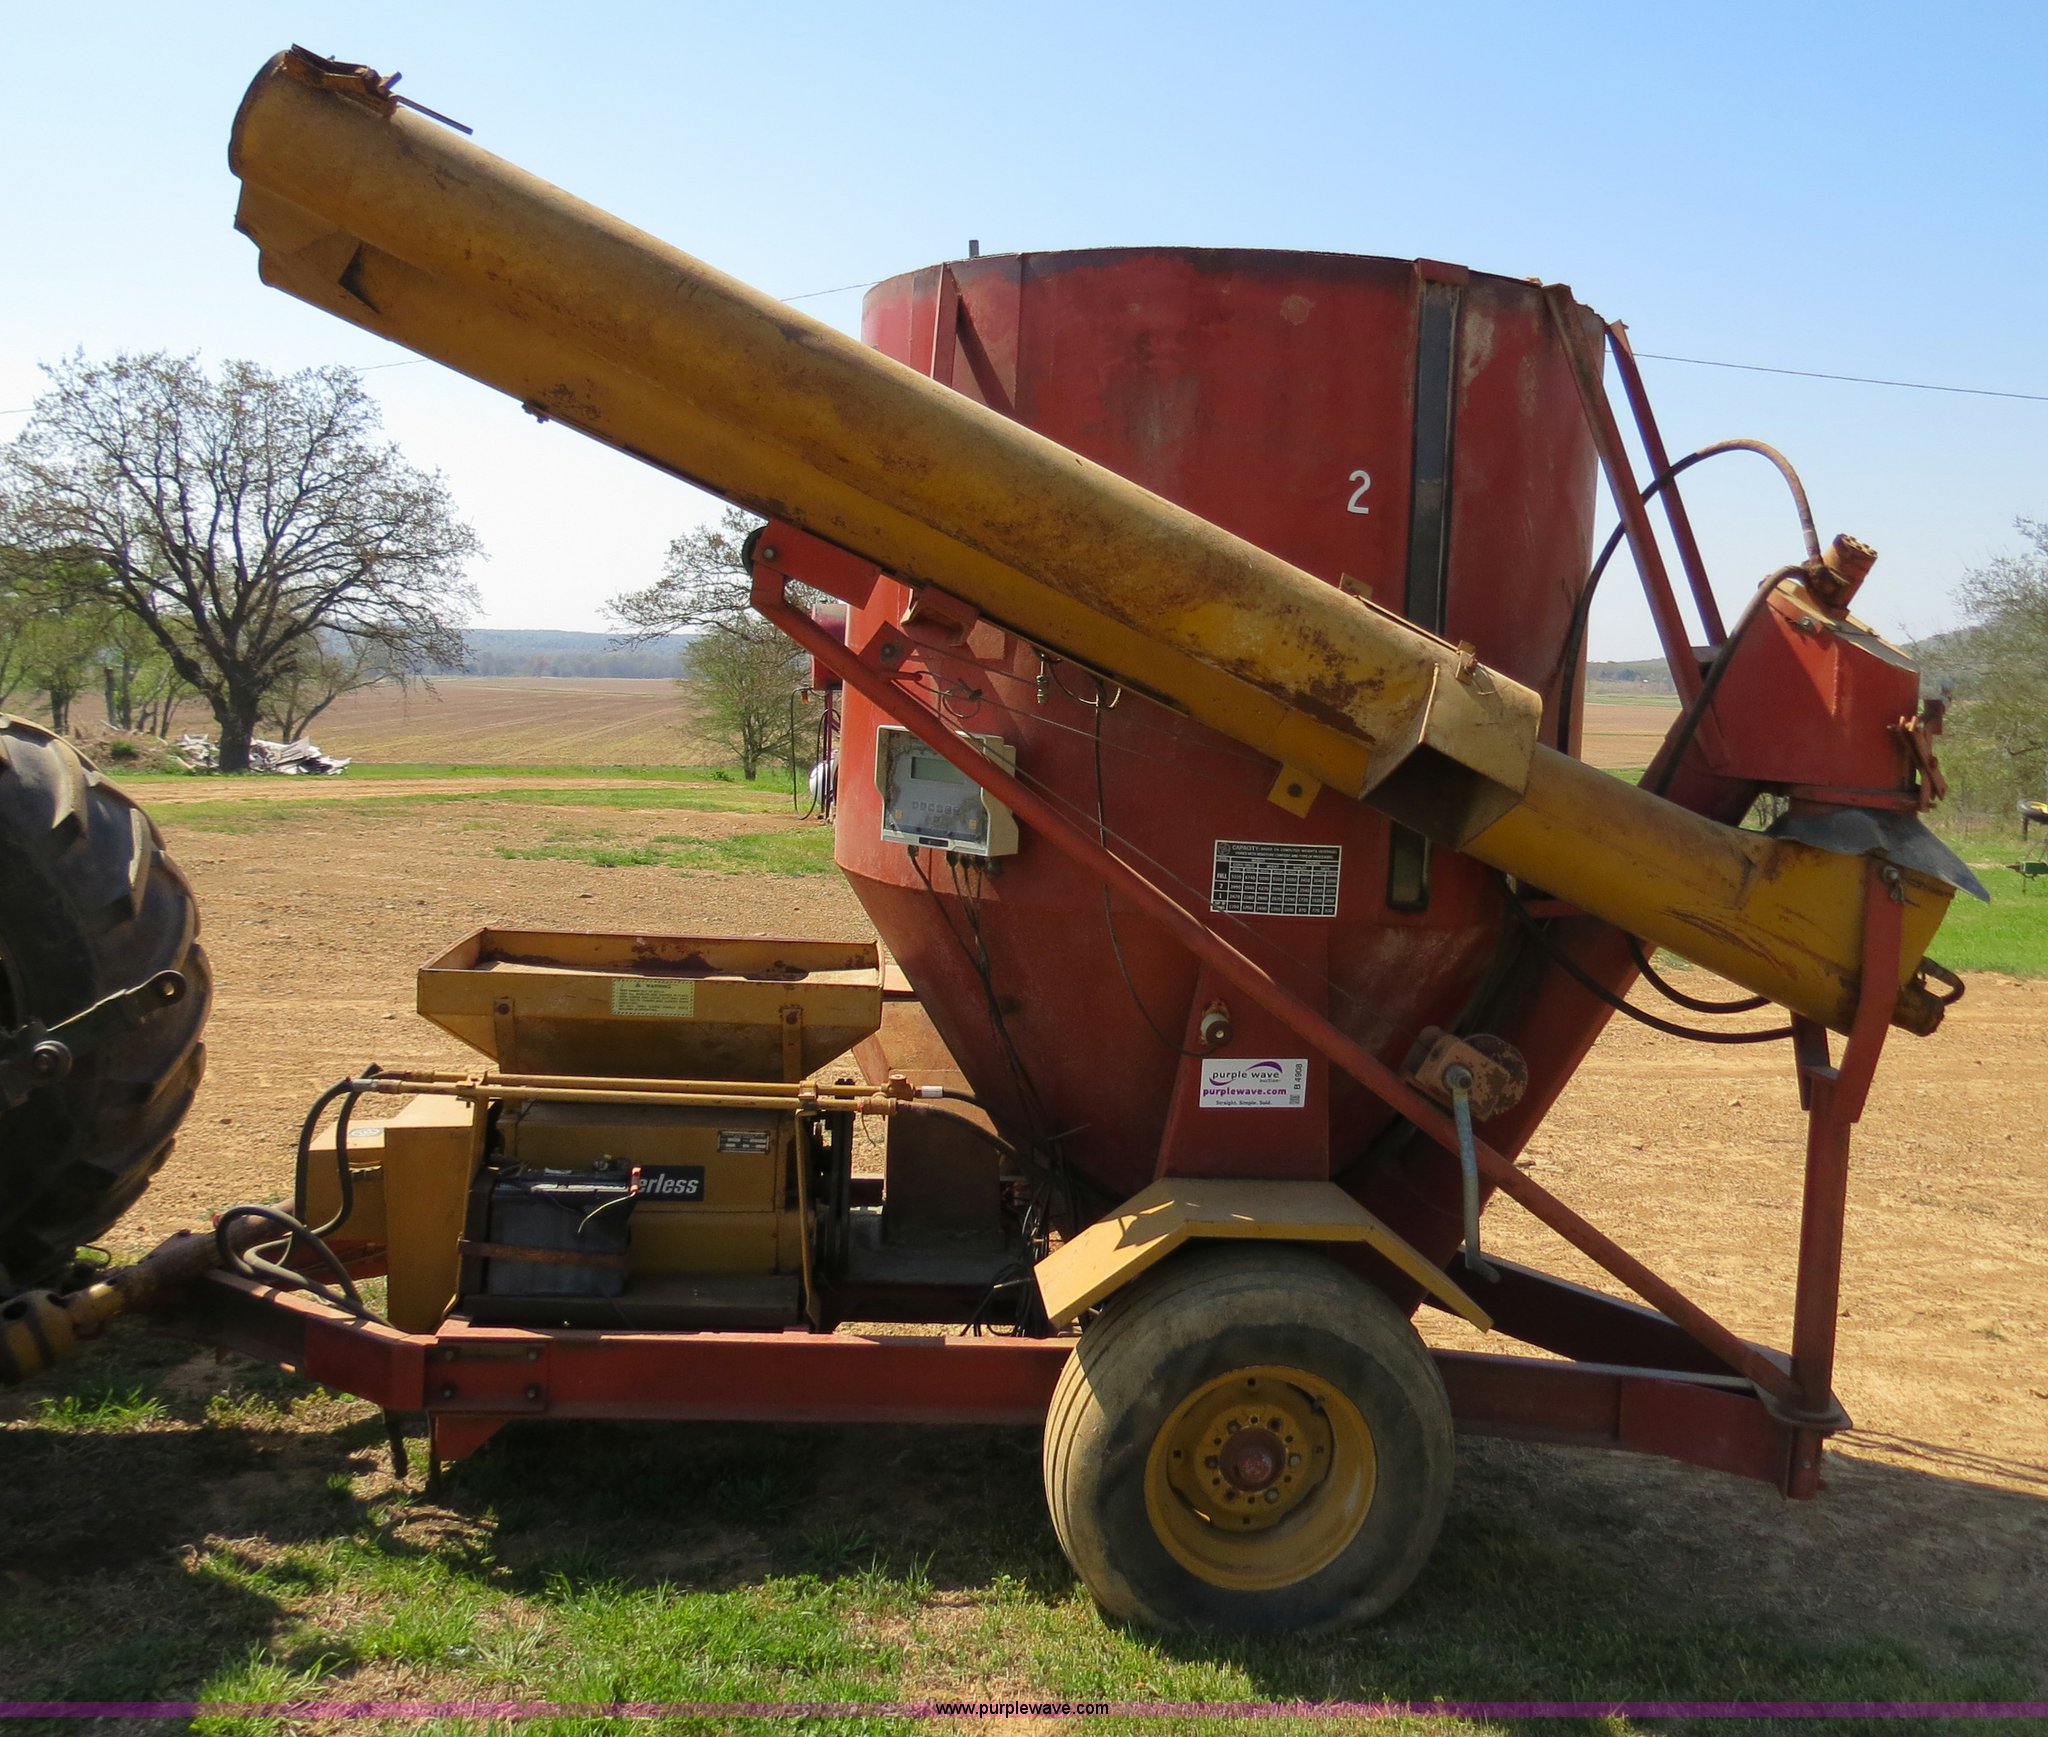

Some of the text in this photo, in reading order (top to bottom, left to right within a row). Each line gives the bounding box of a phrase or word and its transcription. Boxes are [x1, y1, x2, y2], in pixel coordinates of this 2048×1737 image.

[1347, 470, 1371, 514] 2
[1212, 1070, 1248, 1079] purple
[1203, 1087, 1286, 1096] purplewave.com
[639, 1173, 700, 1194] erless
